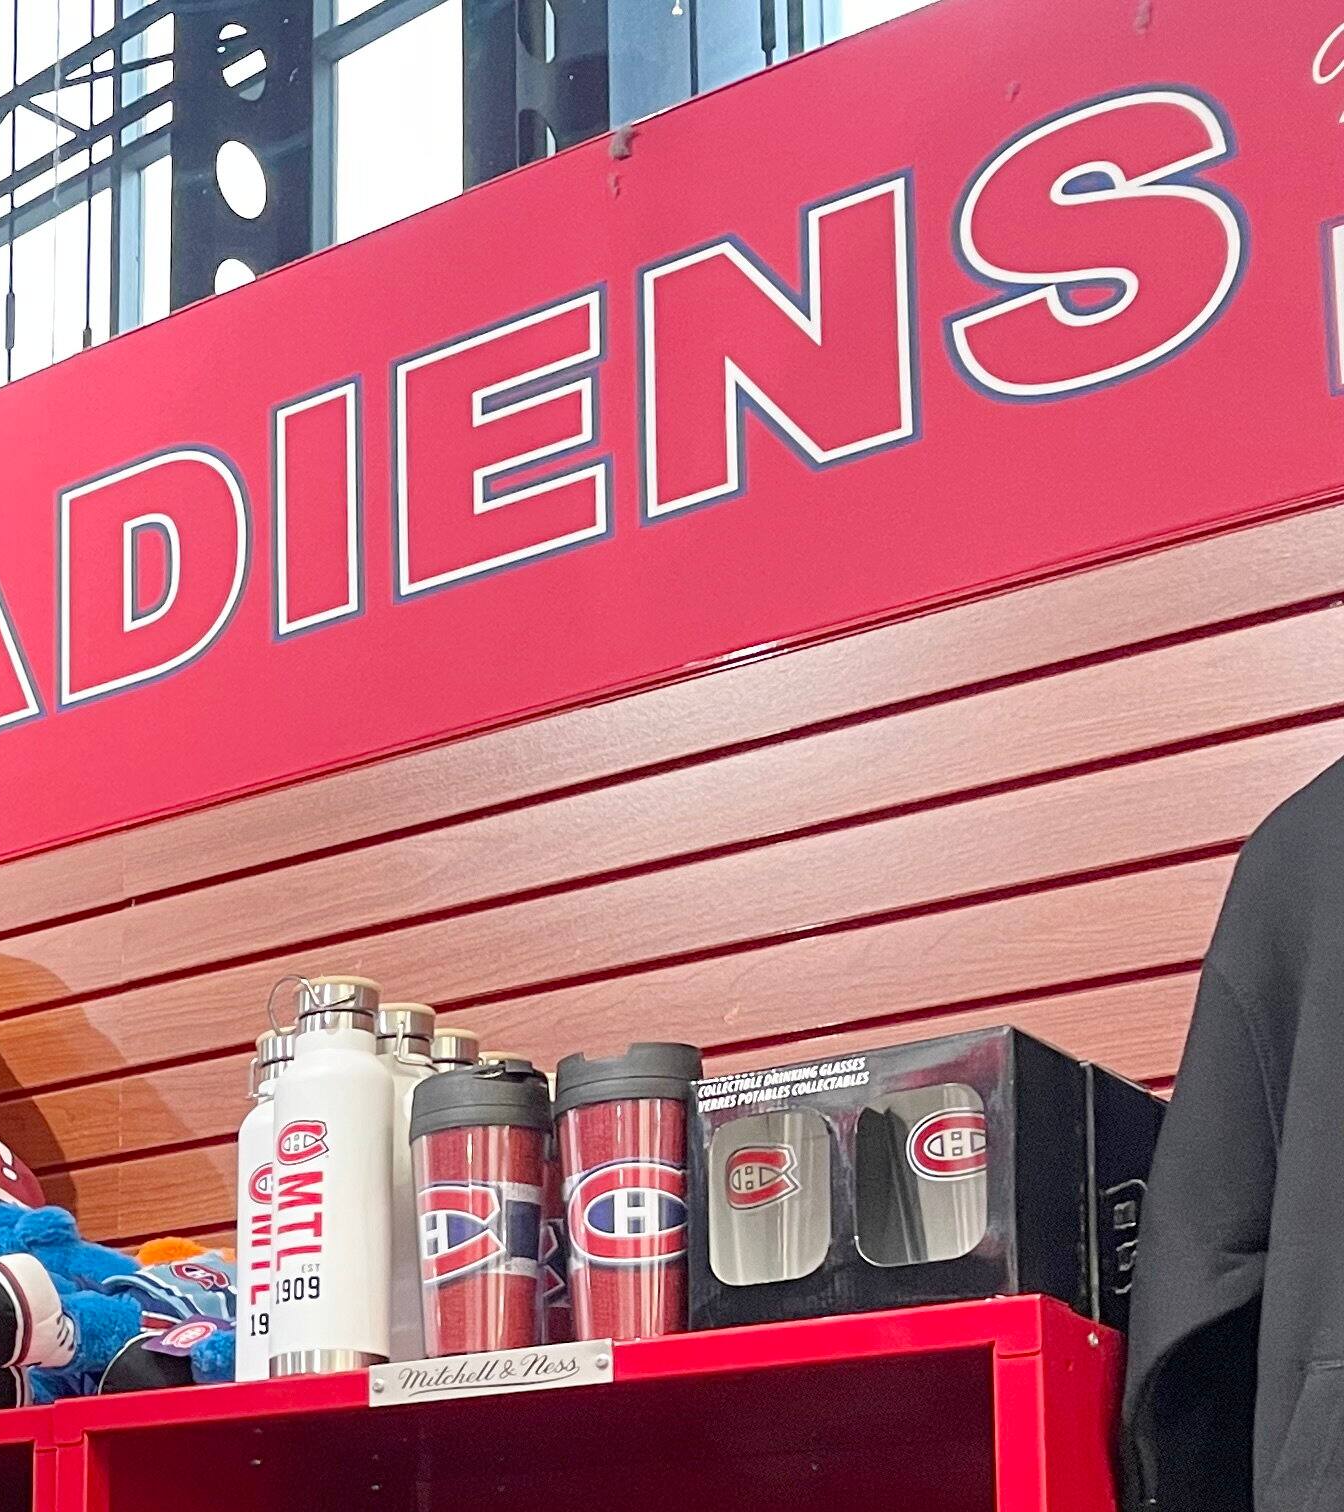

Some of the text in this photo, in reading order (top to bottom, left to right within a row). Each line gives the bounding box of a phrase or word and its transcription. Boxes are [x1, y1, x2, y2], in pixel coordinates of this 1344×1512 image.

[697, 1075, 764, 1098] COLLECTIBLE
[764, 1065, 818, 1086] DRINKING
[819, 1057, 866, 1077] GLASSES
[697, 1094, 737, 1113] VERRES
[737, 1085, 791, 1106] POTABLES
[791, 1071, 870, 1097] COLLECTABLES
[276, 1170, 324, 1272] MTL
[276, 1275, 321, 1305] 1909
[398, 1353, 581, 1391] Mitchell & Ness
